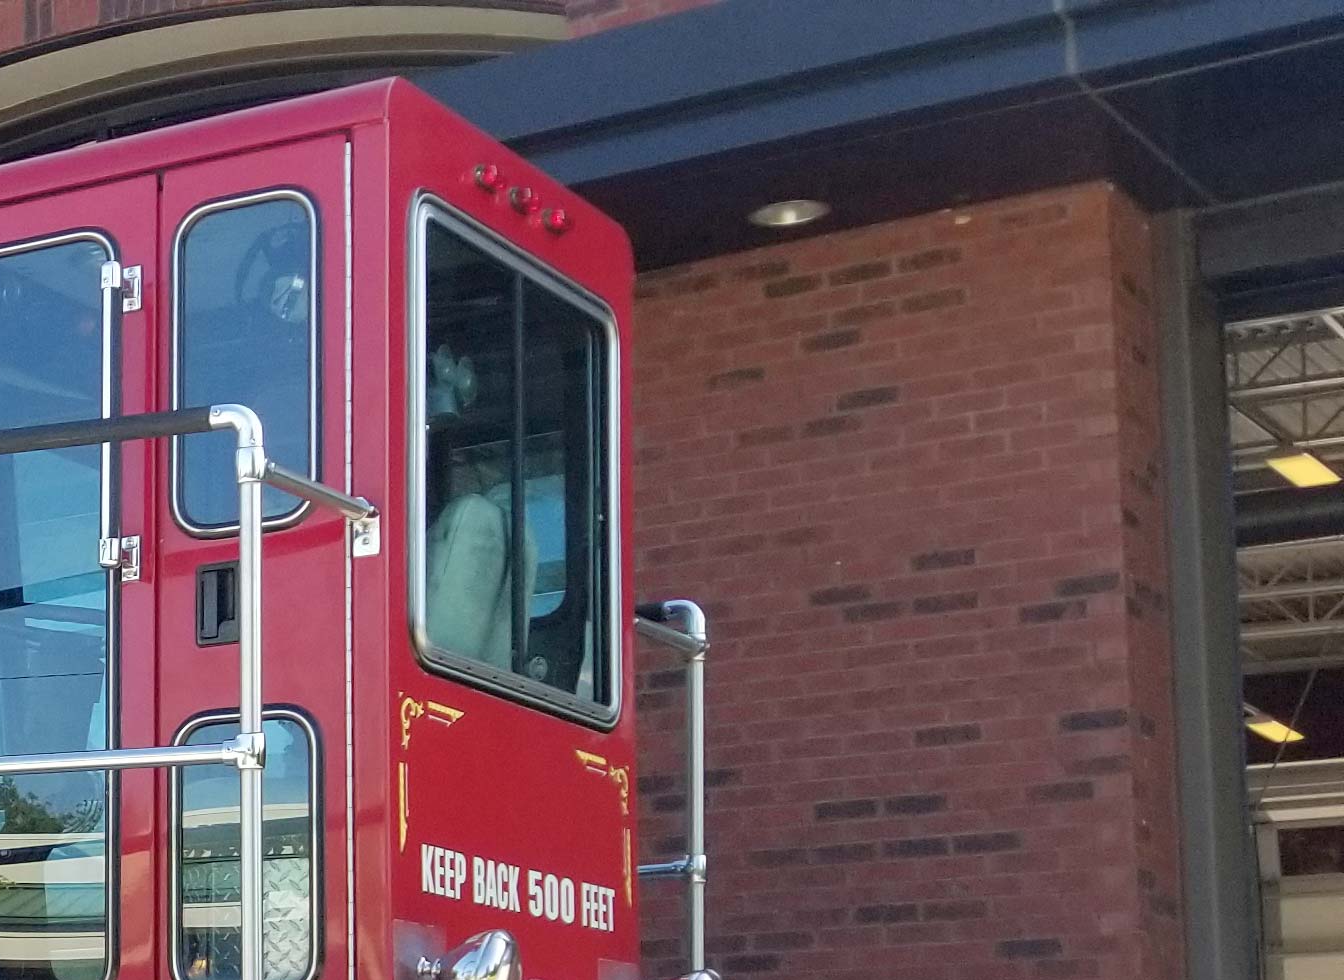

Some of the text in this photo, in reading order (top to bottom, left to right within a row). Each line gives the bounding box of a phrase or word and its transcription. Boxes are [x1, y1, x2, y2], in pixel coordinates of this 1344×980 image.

[421, 844, 616, 932] KEEP BACK 500 FEET
